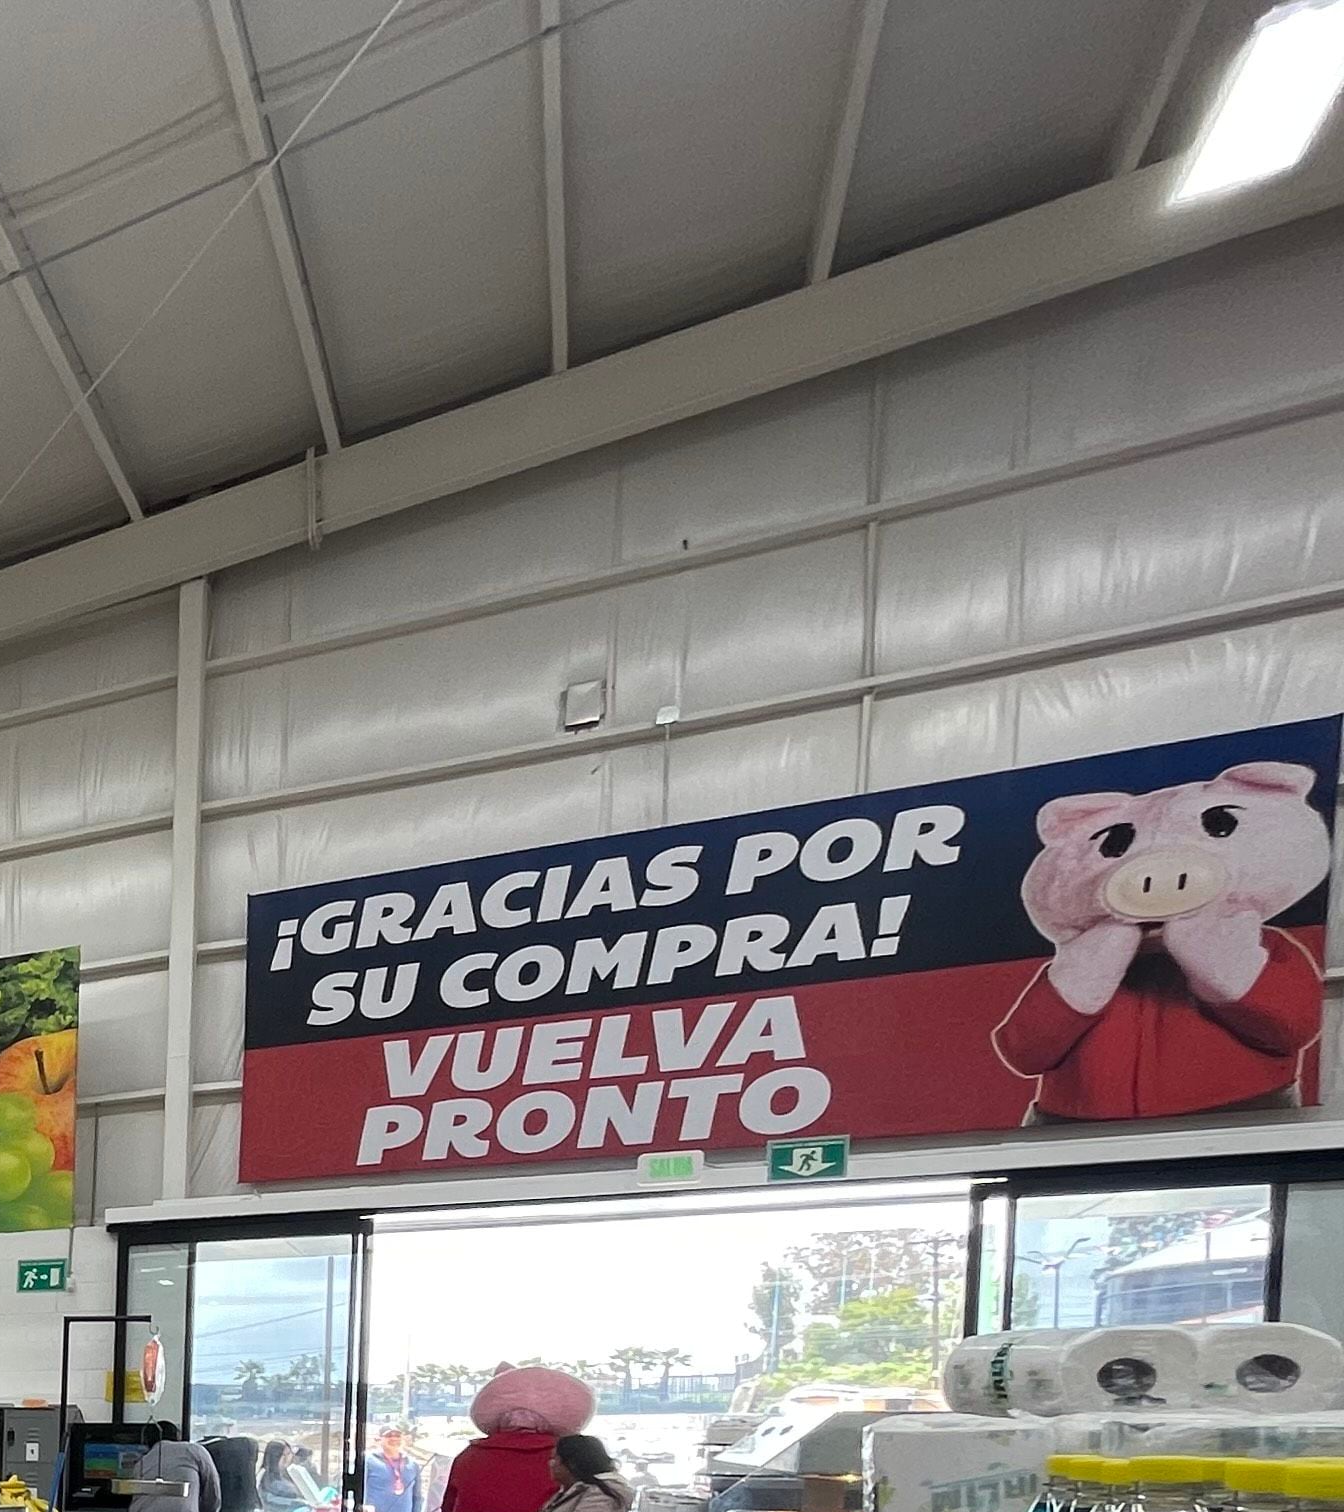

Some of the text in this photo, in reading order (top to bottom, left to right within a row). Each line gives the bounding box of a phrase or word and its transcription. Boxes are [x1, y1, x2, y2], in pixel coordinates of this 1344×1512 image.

[270, 804, 965, 972] ¡GRACIAS POR
[306, 895, 912, 1028] SU COMPRA!
[382, 995, 807, 1099] VUELVA
[356, 1065, 832, 1167] PRONTO
